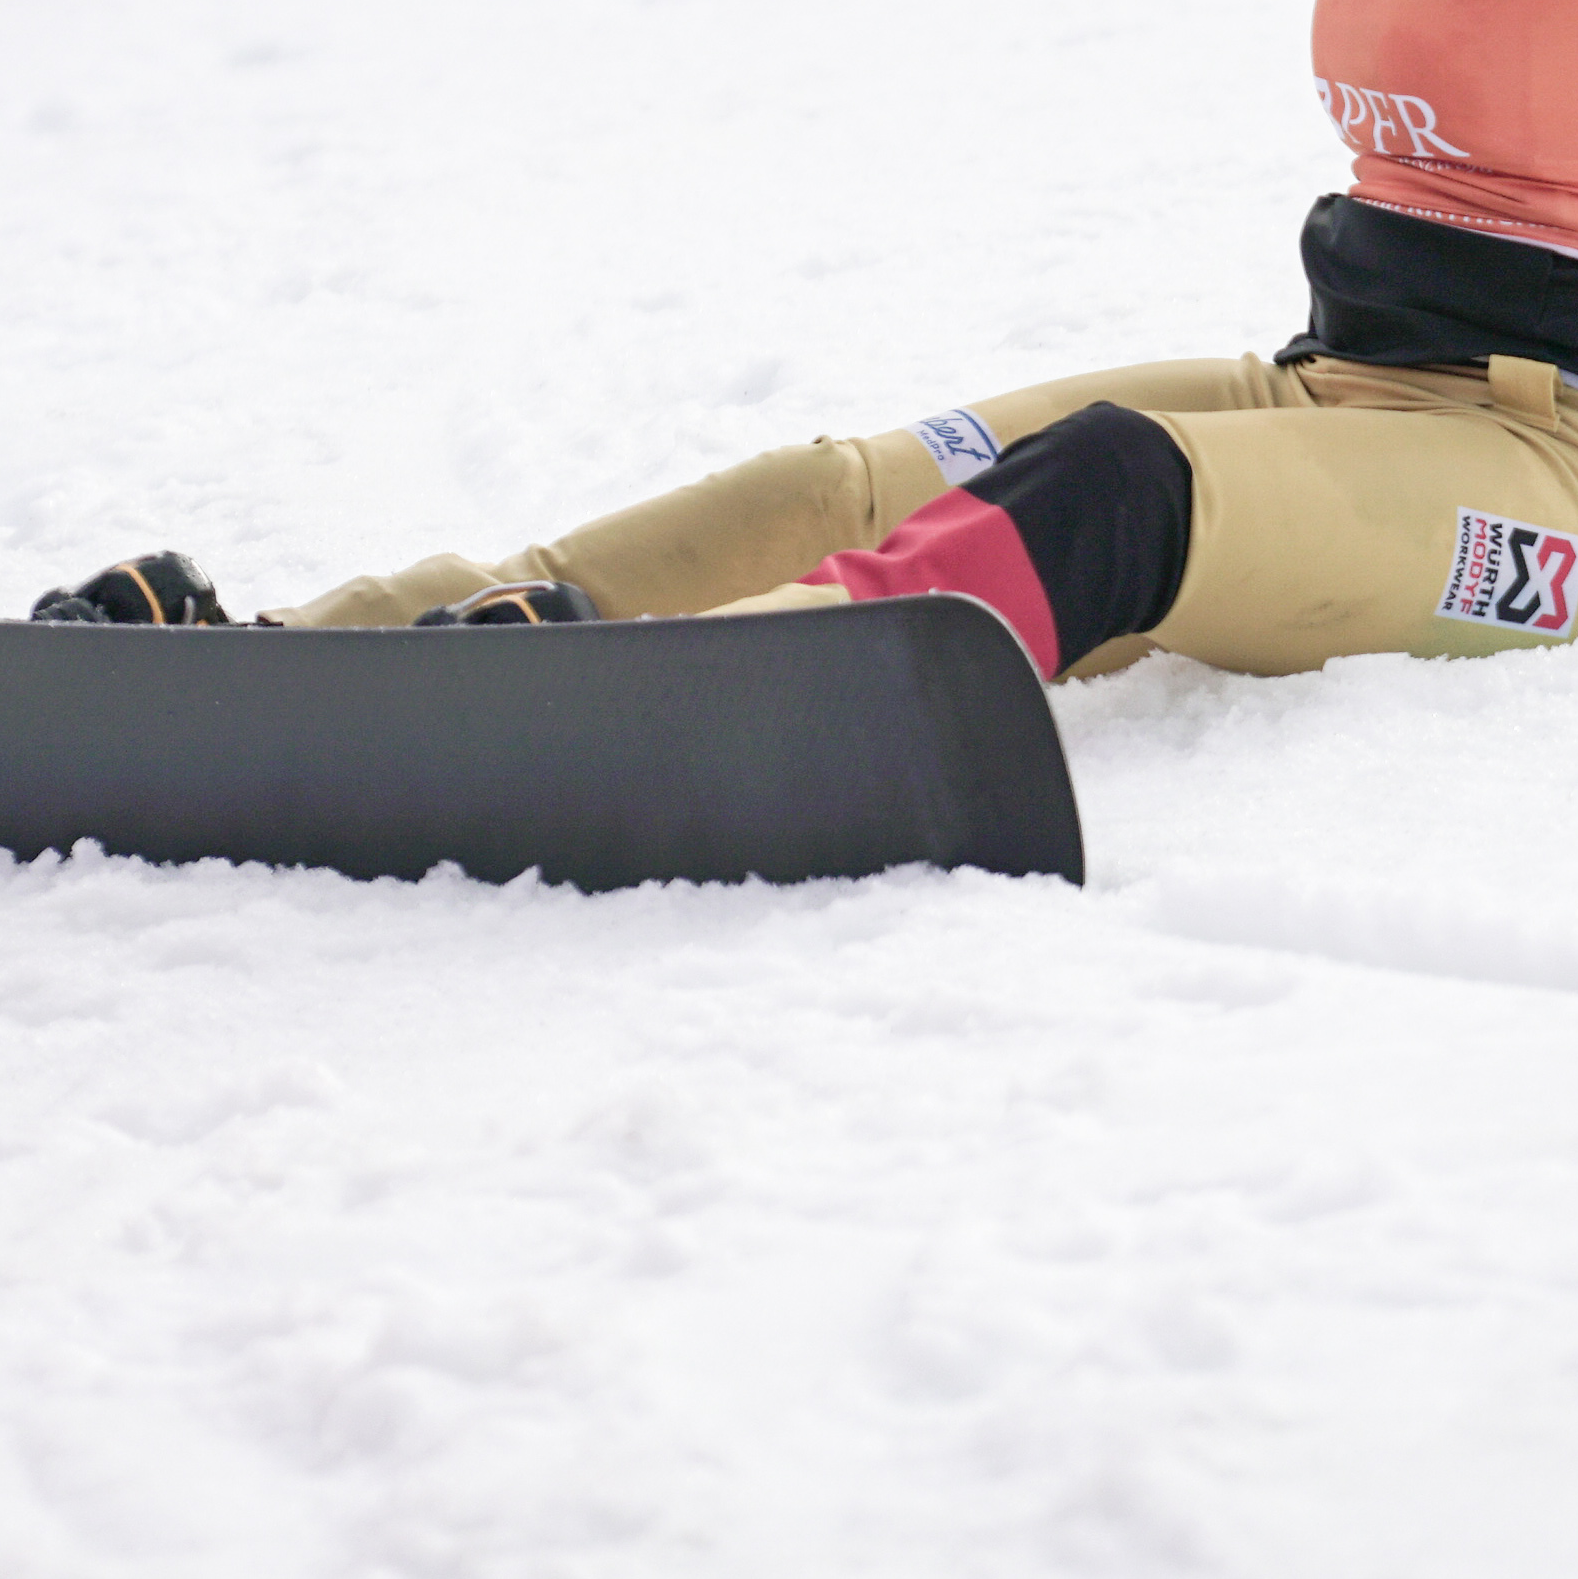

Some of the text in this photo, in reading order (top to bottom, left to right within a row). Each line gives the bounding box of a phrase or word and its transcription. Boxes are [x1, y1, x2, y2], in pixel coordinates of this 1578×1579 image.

[1334, 81, 1471, 157] PFR
[916, 429, 945, 461] MedPro
[919, 416, 991, 461] bert
[1441, 515, 1471, 611] WORKWEAR
[1460, 517, 1488, 615] MODYF
[1471, 522, 1503, 617] WÜRTH
